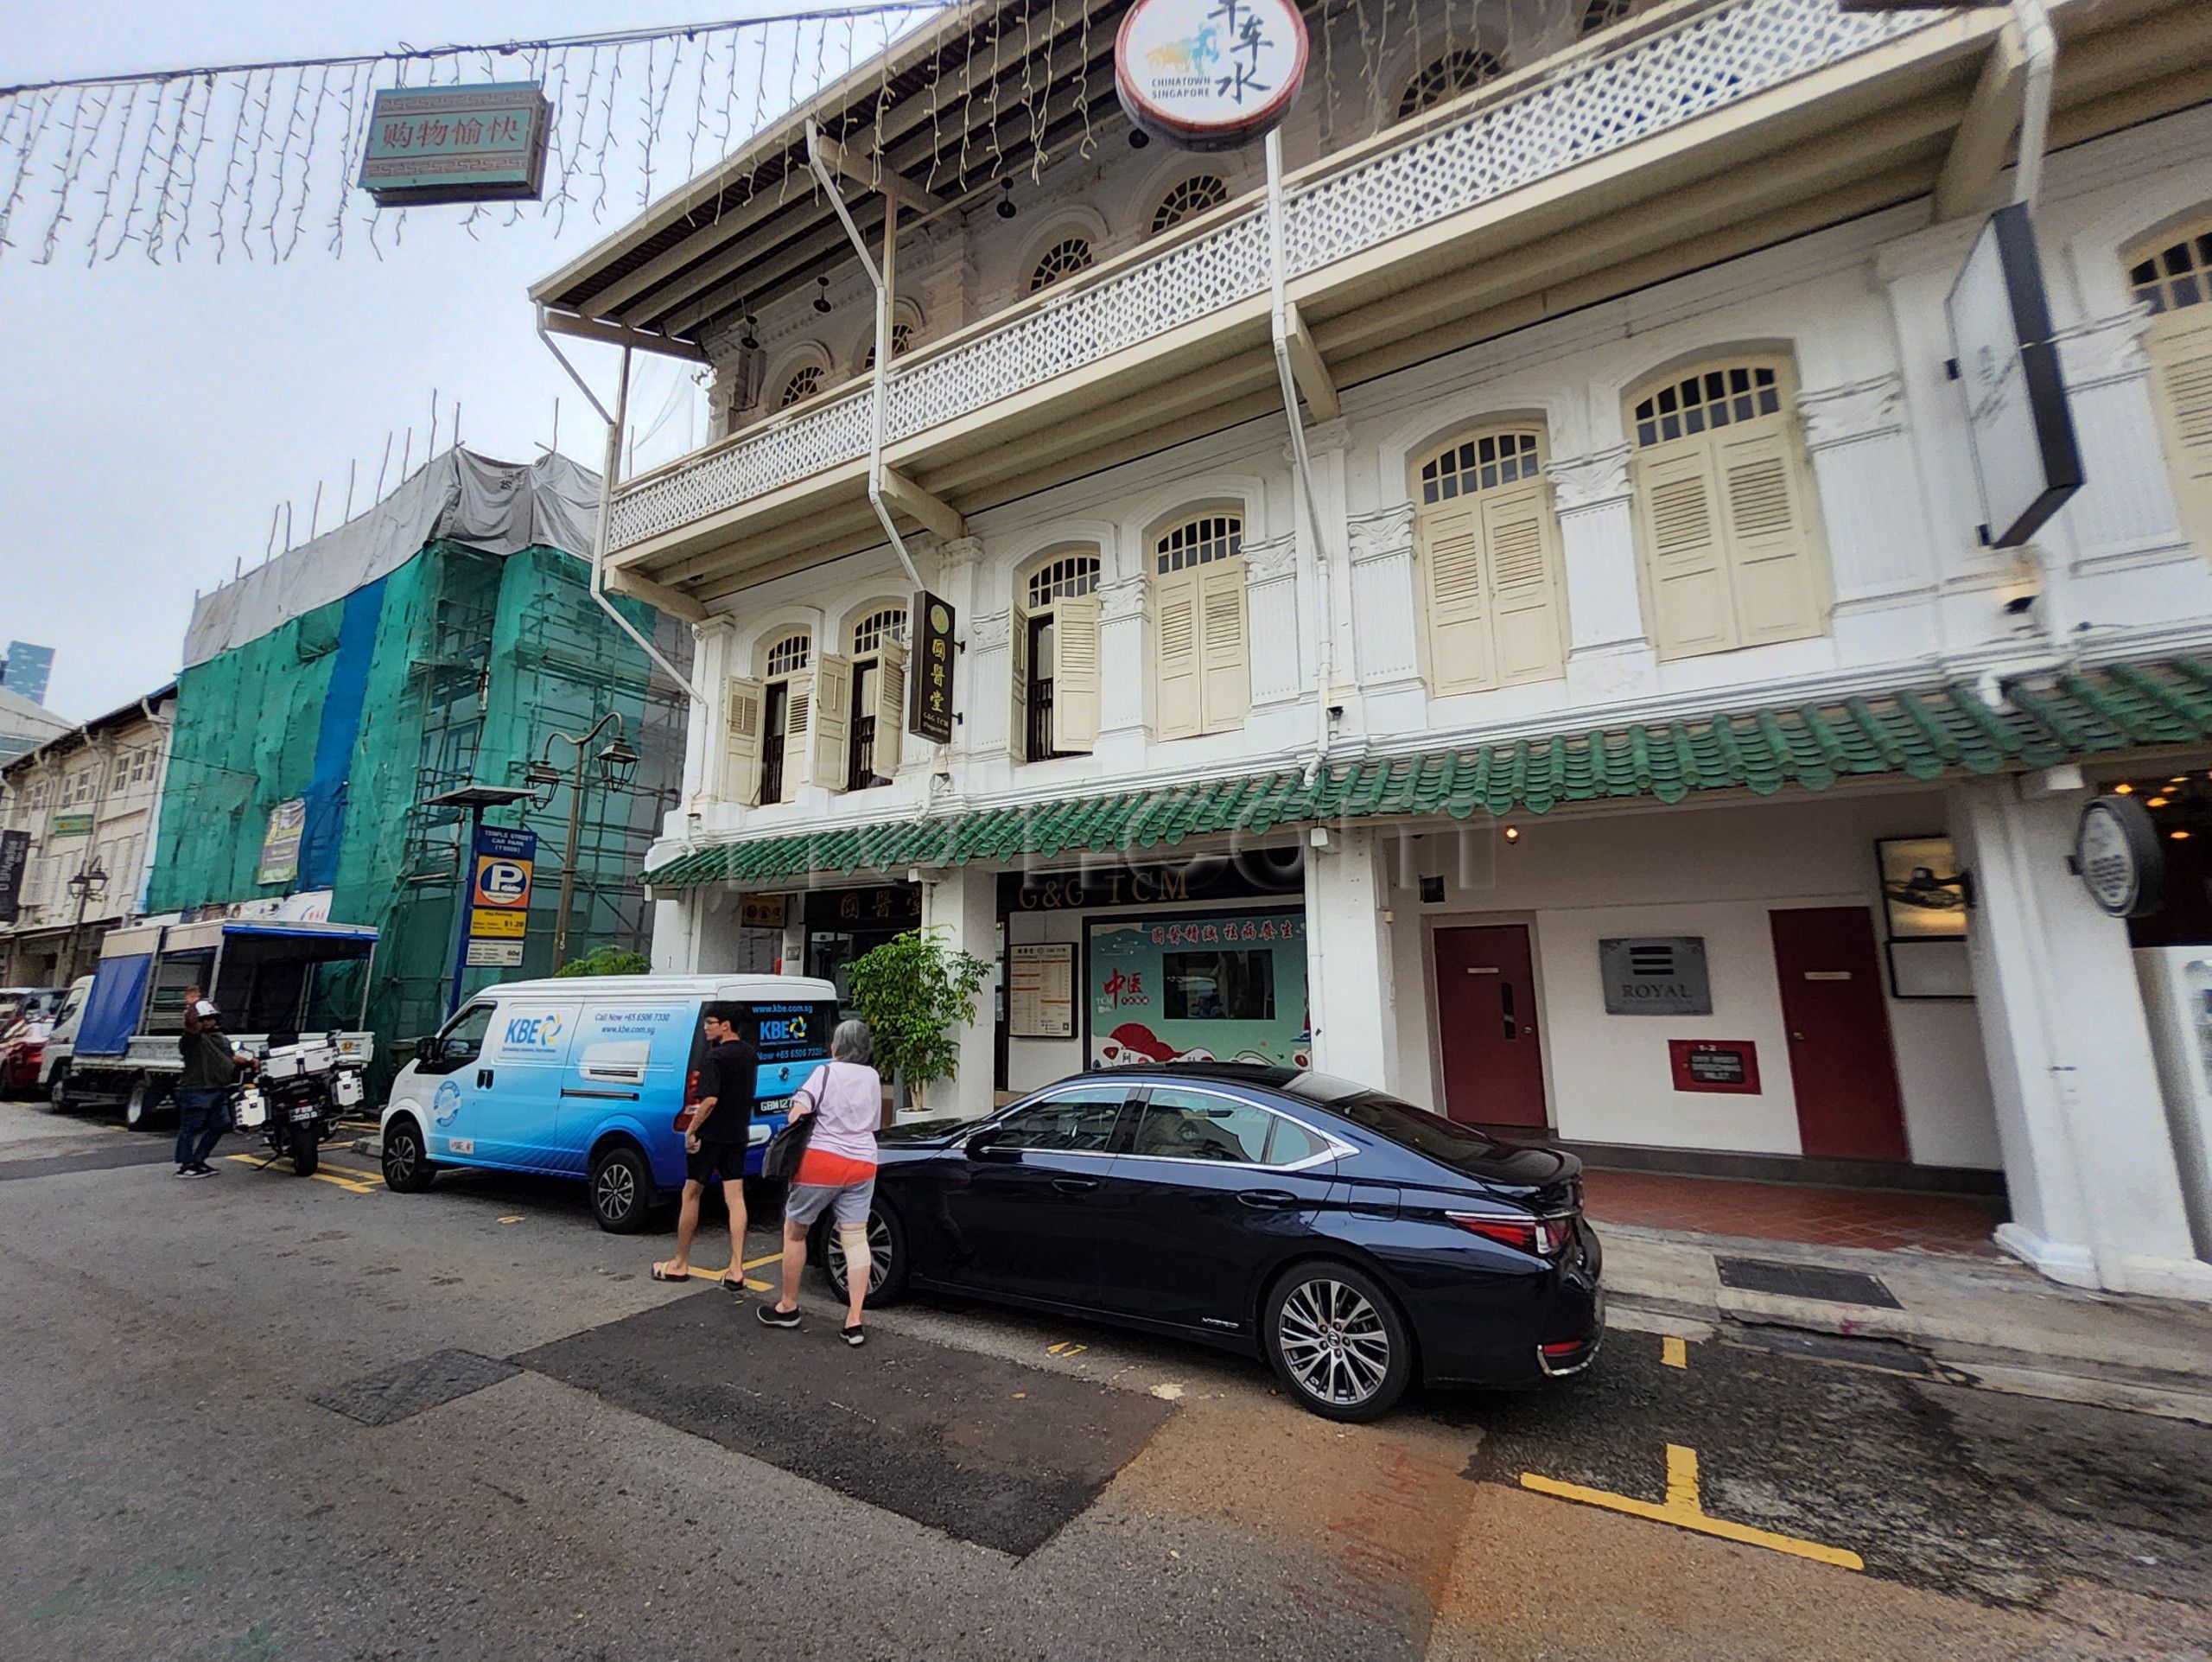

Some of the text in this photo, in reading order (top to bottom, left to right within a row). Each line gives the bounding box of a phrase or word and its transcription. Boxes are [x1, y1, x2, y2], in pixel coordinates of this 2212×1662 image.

[1151, 76, 1211, 88] CHINATOWN
[1152, 89, 1210, 100] SINGAPORE
[380, 116, 520, 150] 购物愉快
[485, 830, 508, 838] TEMPLE
[491, 865, 523, 891] P
[1018, 869, 1190, 909] G&G TCM
[1103, 967, 1143, 1010] 中医
[1621, 984, 1693, 999] ROYAL
[752, 1004, 813, 1014] www.kbe.com.sg
[594, 1013, 608, 1022] Call
[504, 1018, 542, 1044] KBE
[601, 1026, 656, 1035] www.kbe.com.sg
[760, 1021, 790, 1041] KBE
[775, 1050, 789, 1060] +65
